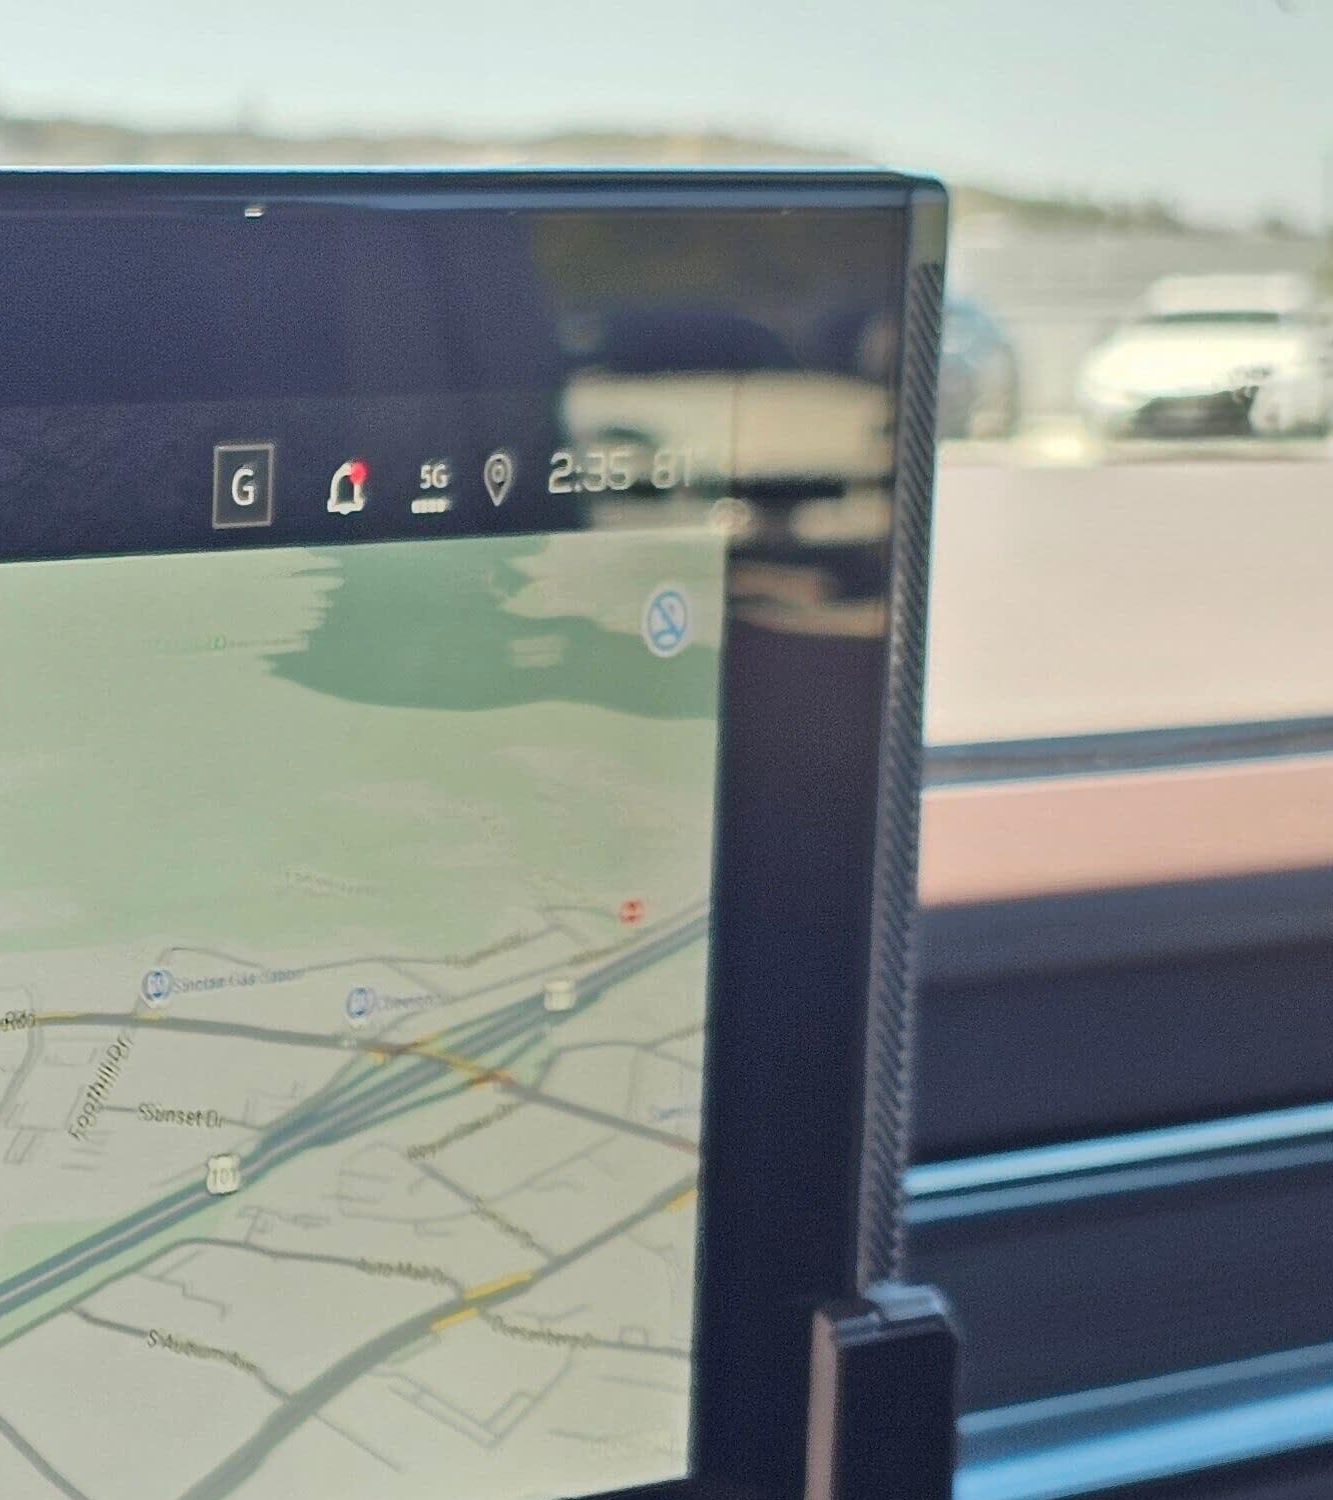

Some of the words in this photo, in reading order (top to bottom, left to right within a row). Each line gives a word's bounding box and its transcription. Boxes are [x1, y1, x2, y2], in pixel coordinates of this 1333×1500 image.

[231, 467, 256, 506] G
[419, 463, 450, 490] 5G
[548, 451, 634, 494] 2:35
